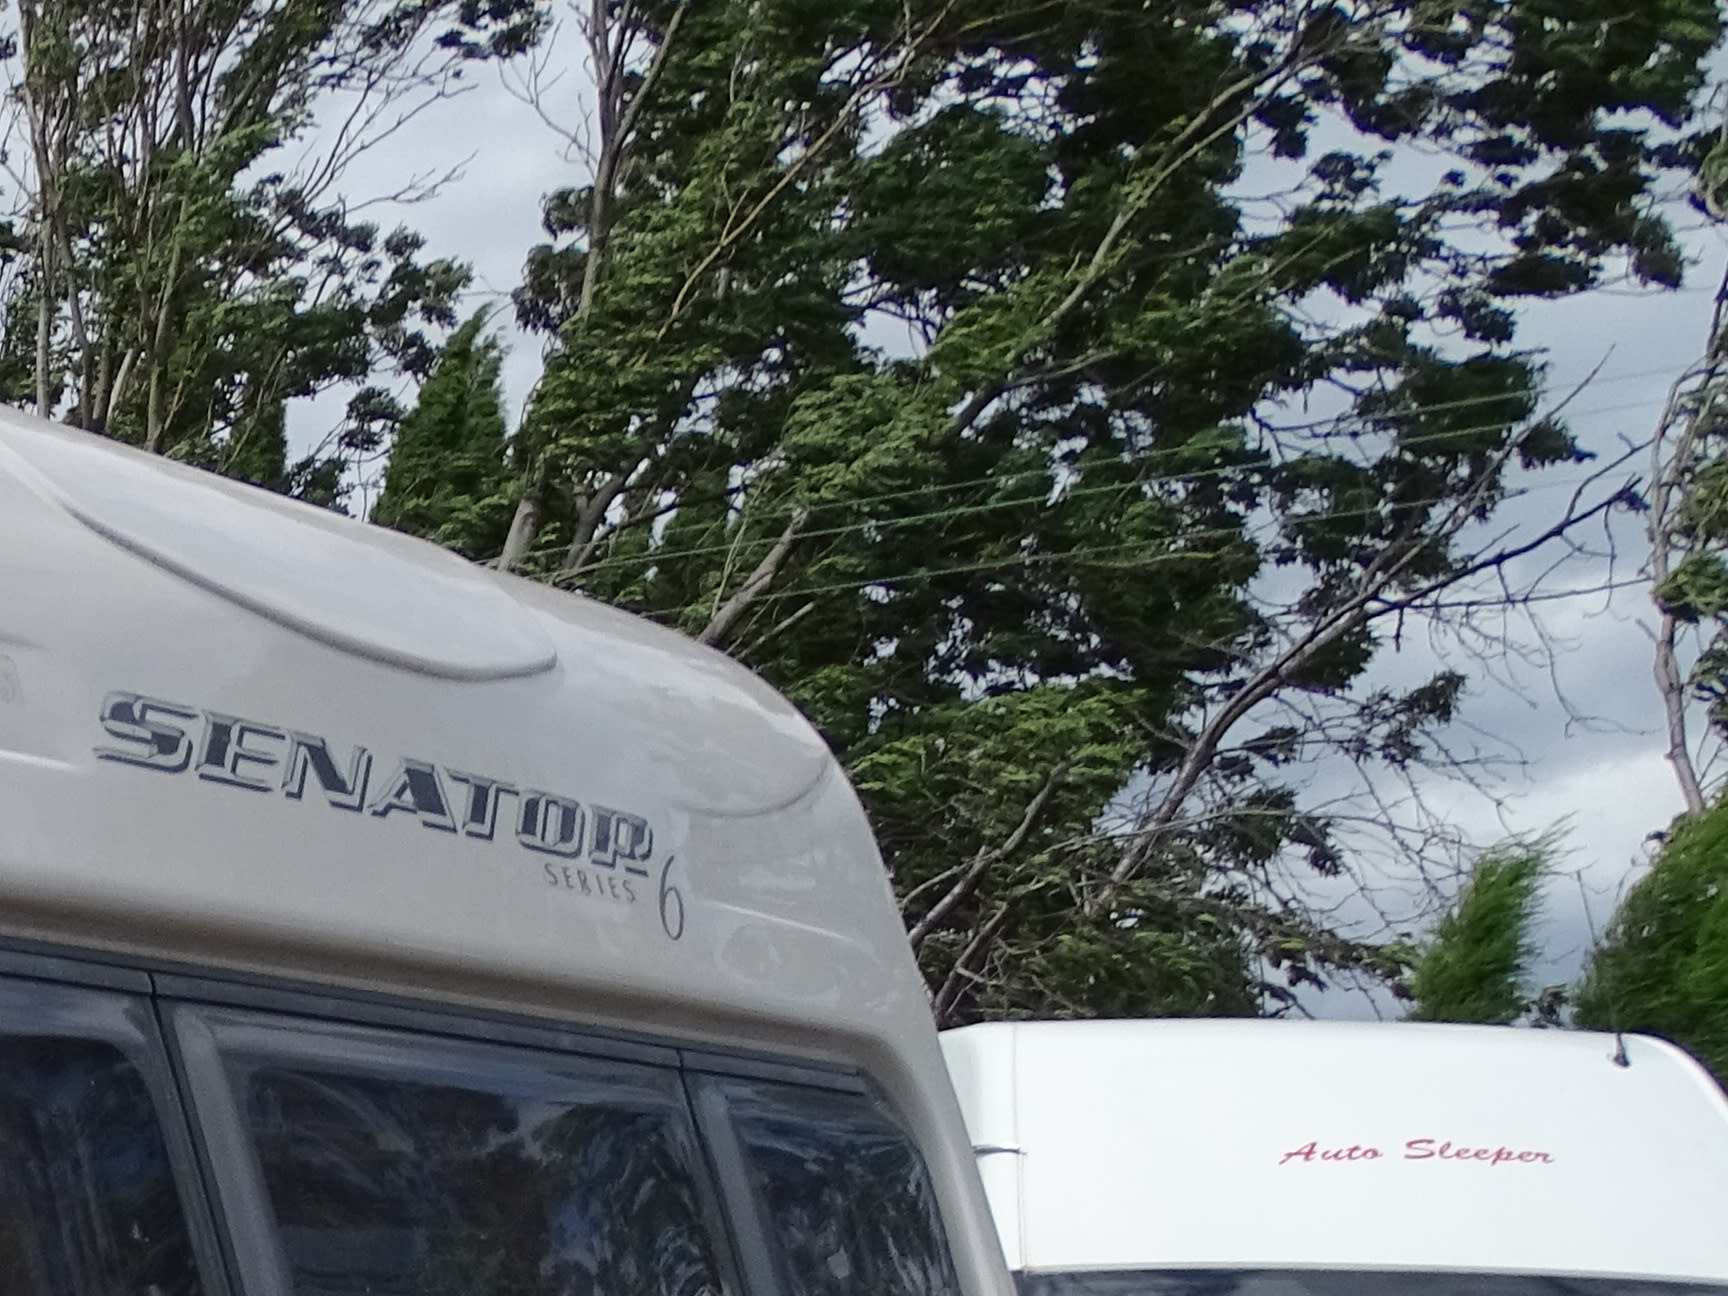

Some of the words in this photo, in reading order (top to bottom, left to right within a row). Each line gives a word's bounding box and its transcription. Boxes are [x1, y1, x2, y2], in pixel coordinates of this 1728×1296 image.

[92, 690, 654, 877] SENATOR
[544, 862, 639, 904] SERIES
[658, 853, 685, 941] 6
[1278, 1141, 1384, 1166] Auto
[1403, 1138, 1555, 1167] Sleeper
